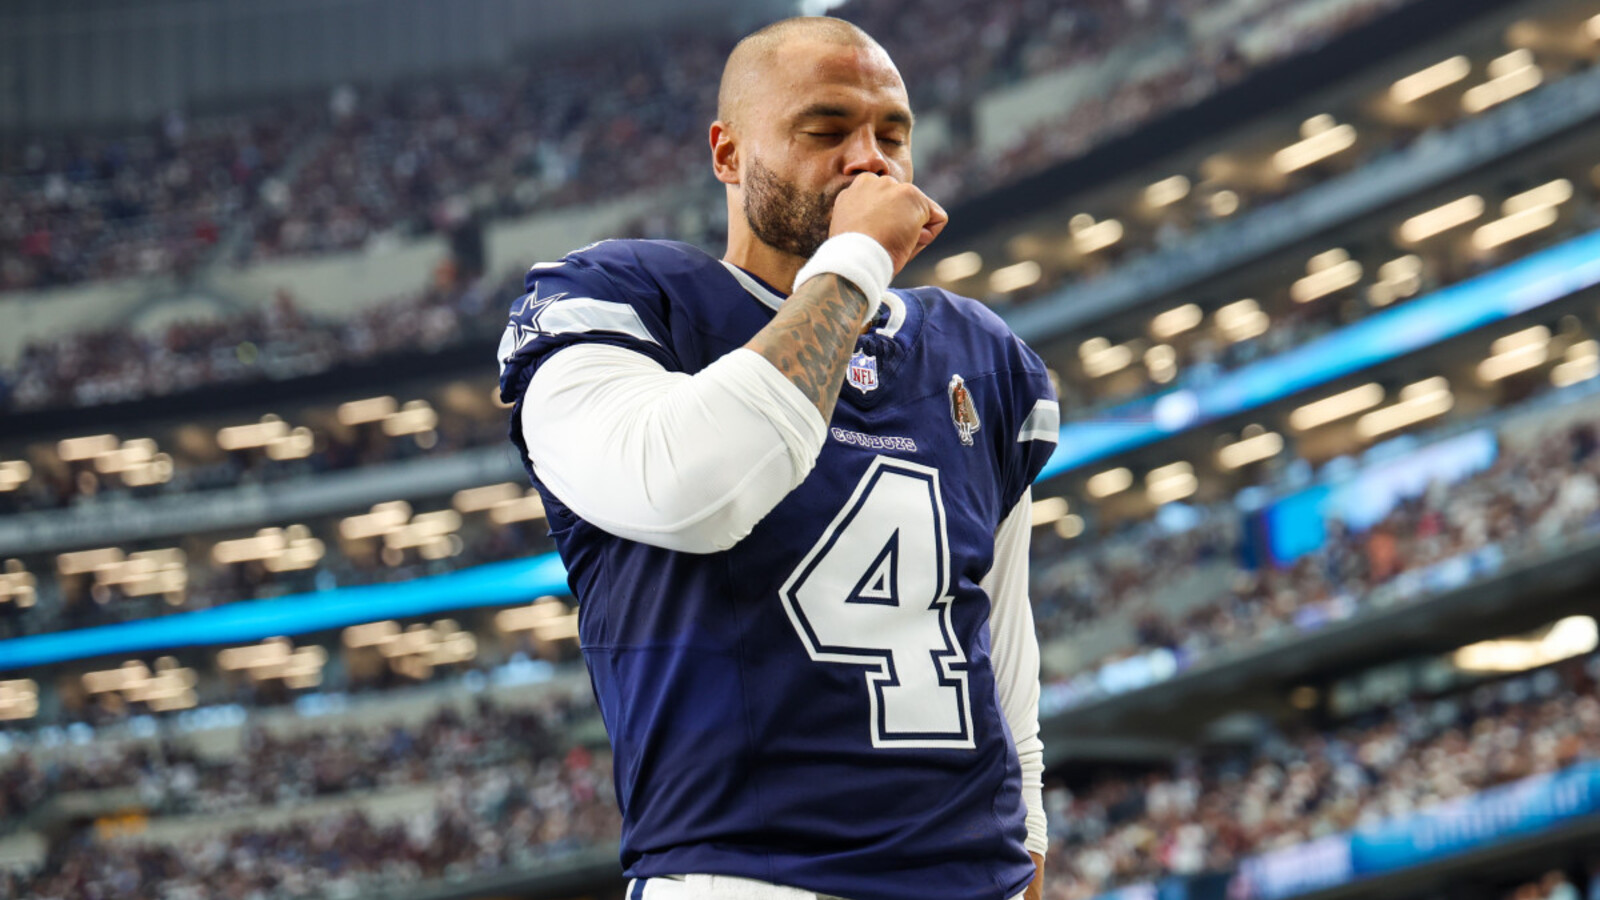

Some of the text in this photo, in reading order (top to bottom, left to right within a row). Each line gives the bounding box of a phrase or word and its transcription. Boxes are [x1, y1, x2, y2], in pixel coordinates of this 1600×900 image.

[852, 368, 874, 386] NFL
[831, 428, 917, 452] COWBOYS
[778, 454, 976, 748] 4
